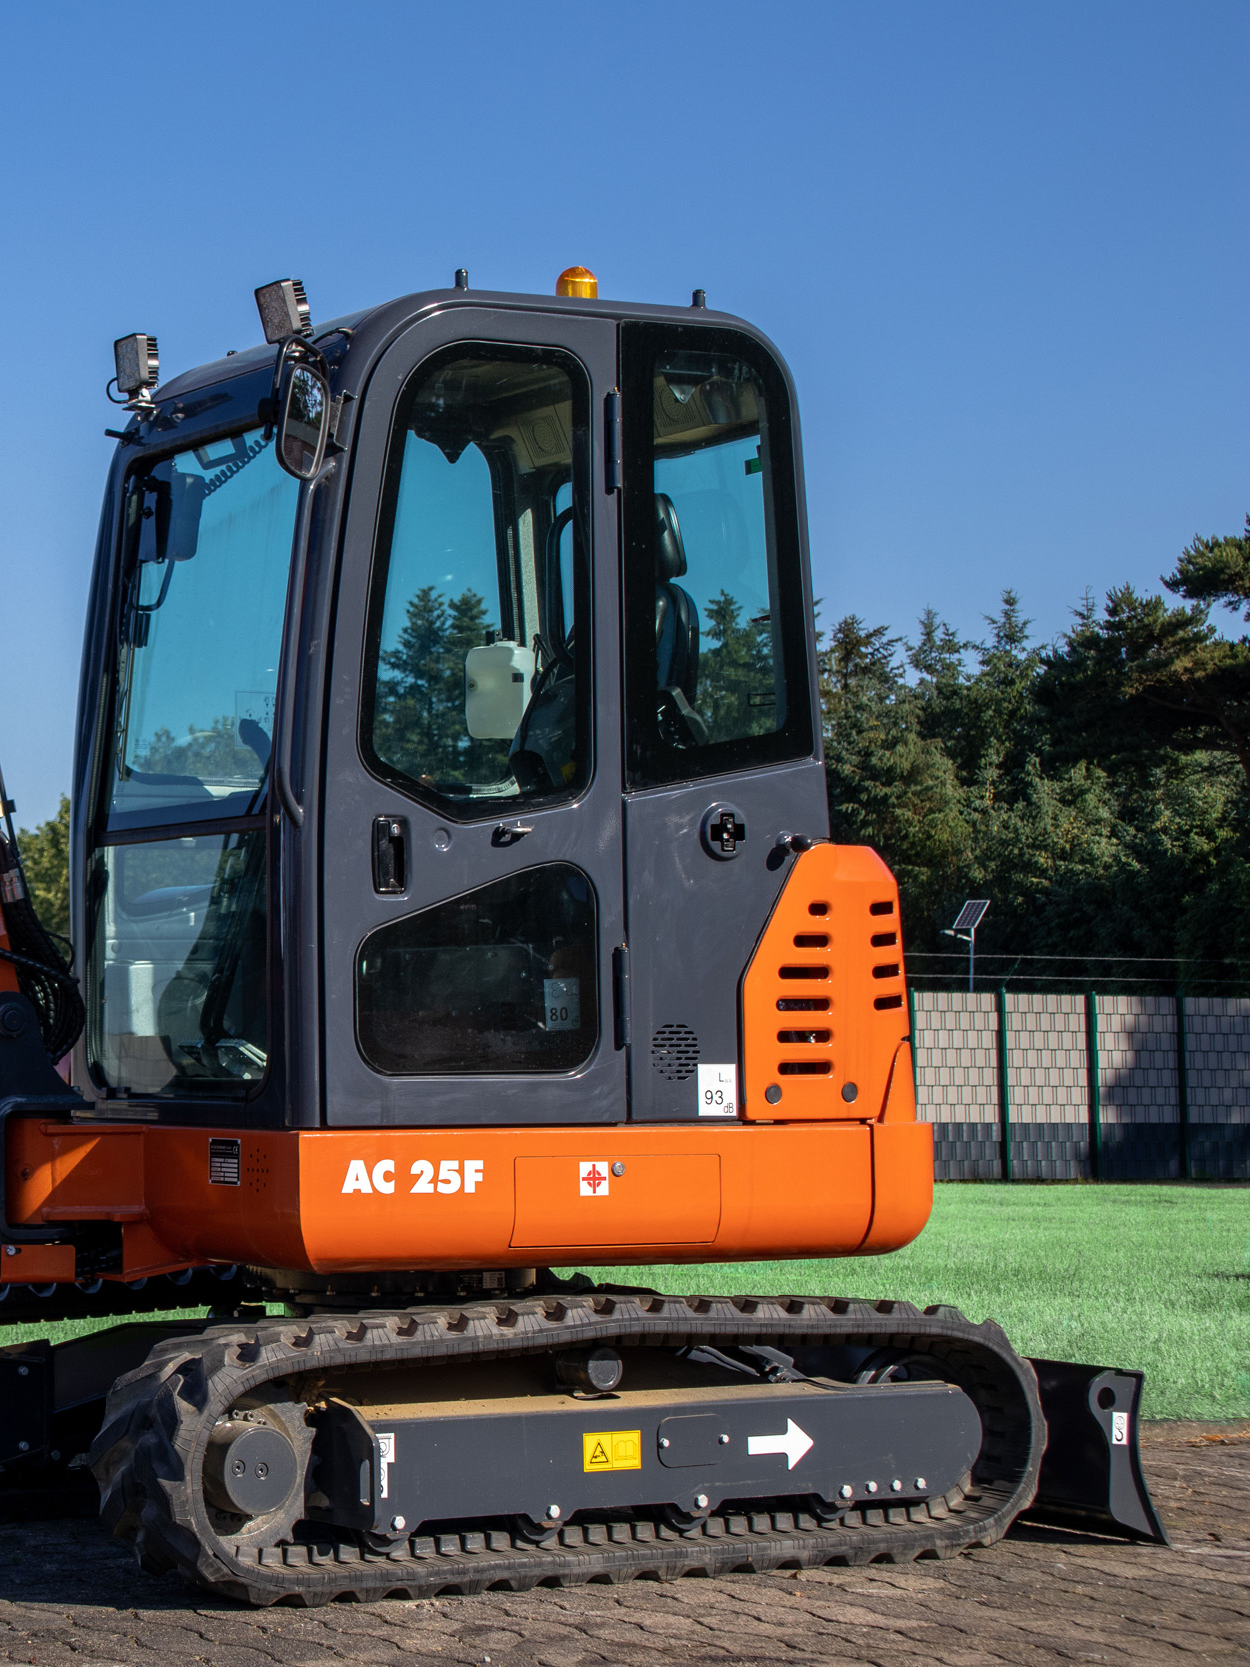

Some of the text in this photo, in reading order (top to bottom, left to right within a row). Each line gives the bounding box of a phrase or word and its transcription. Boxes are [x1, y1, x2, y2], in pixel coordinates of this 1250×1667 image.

[550, 1007, 568, 1021] 80
[705, 1090, 723, 1105] 93
[723, 1103, 734, 1113] dB
[341, 1159, 484, 1194] AC 25F
